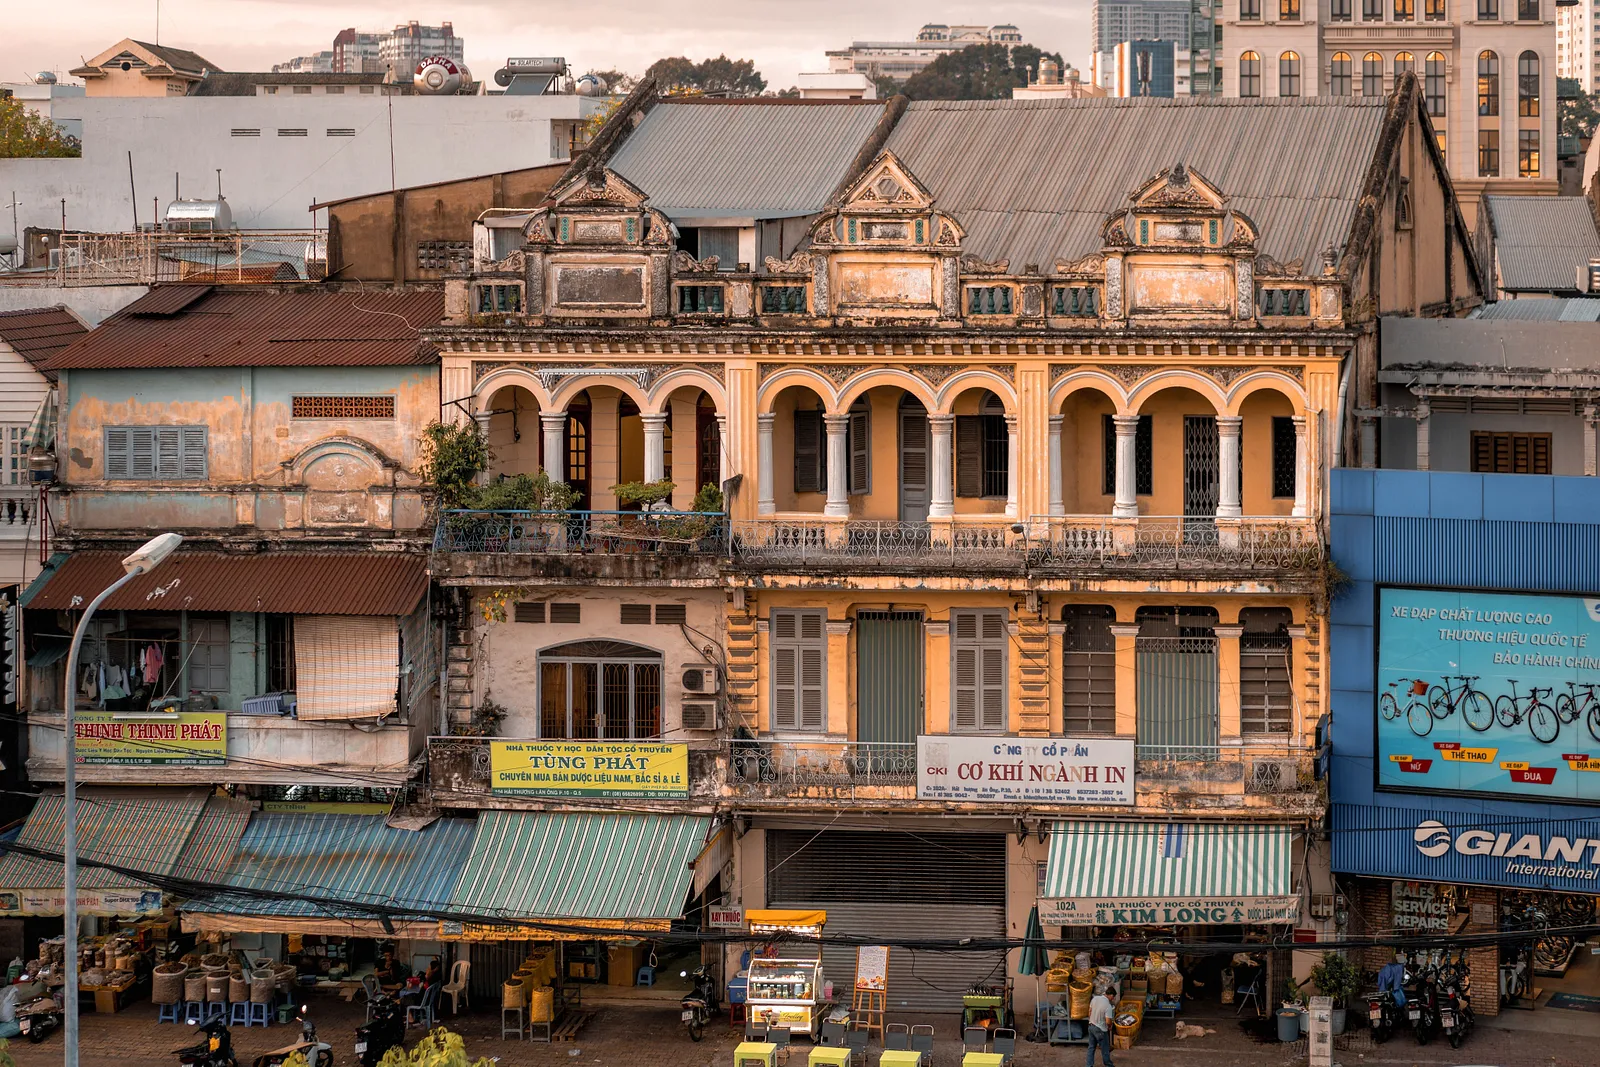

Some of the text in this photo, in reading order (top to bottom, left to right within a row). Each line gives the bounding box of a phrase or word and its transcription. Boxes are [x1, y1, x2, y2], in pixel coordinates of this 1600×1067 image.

[420, 57, 453, 69] DAPHA
[1391, 605, 1552, 625] XE ĐẠP CHẤT LƯỢNG CAO
[1438, 628, 1589, 648] THƯƠNG HIỆU QUỐC TẾ
[1493, 650, 1521, 665] BẢO
[1523, 653, 1562, 668] HÀNH
[74, 719, 223, 743] THỊNH THỊNH PHÁT
[525, 744, 554, 752] THUỐC
[606, 745, 622, 754] TỘC
[624, 744, 636, 752] CỔ
[638, 745, 672, 753] TRUYỀN
[993, 743, 1021, 755] CNG
[1042, 742, 1057, 755] CỔ
[1451, 750, 1487, 760] THỂ THAO
[529, 752, 649, 770] TÙNG PHÁT
[499, 771, 531, 781] CHUYÊN
[533, 773, 550, 781] MUA
[552, 772, 568, 782] BÁN
[571, 772, 592, 784] DƯỢC
[594, 772, 611, 784] LIỆU
[614, 774, 633, 784] NAM,
[662, 775, 668, 783] &
[671, 772, 680, 784] LẺ
[927, 766, 947, 775] CKI
[957, 760, 1126, 784] CƠ KHÍ NGÀNH IN
[1523, 772, 1542, 781] ĐUA
[1505, 861, 1600, 880] International
[1395, 885, 1435, 899] SALES
[1055, 901, 1076, 910] 102A
[1118, 900, 1152, 908] THUỐC
[1164, 901, 1185, 909] HỌC
[1188, 899, 1201, 908] CỔ
[1204, 899, 1244, 907] TRUYỀN
[1394, 900, 1448, 915] SERVICE
[711, 910, 740, 922] XAY THUỐC
[1112, 908, 1227, 923] KIM LONG
[1394, 914, 1448, 930] REPAIRS
